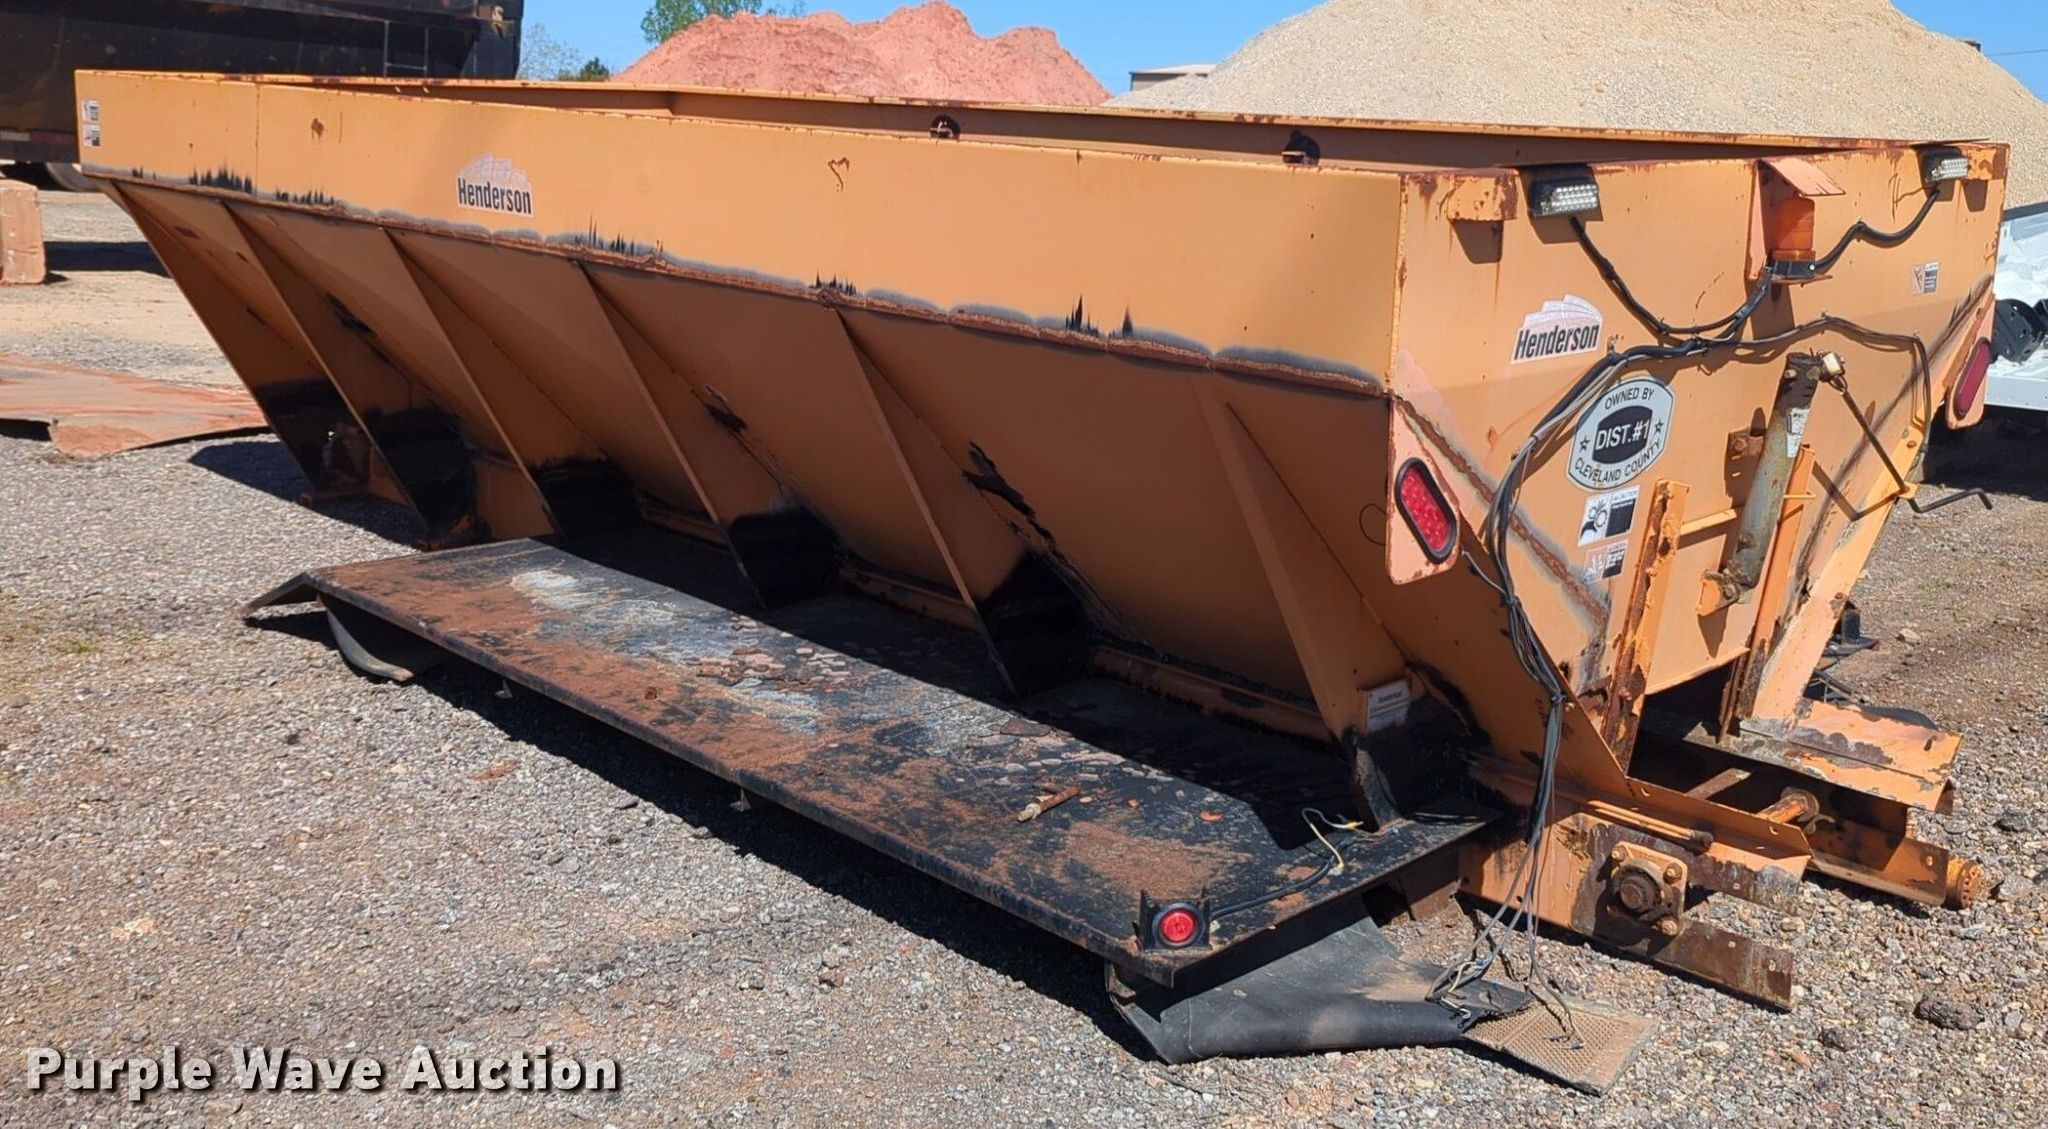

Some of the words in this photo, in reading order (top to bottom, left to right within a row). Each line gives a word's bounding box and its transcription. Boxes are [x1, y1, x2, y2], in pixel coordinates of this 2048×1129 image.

[457, 177, 532, 215] Henderson
[1513, 324, 1600, 361] Henderson
[1604, 387, 1640, 410] OWNED
[1641, 387, 1655, 400] BY
[1595, 419, 1650, 451] DIST.#1
[1575, 457, 1621, 483] CLEVELAND
[1624, 440, 1660, 476] COUNTY
